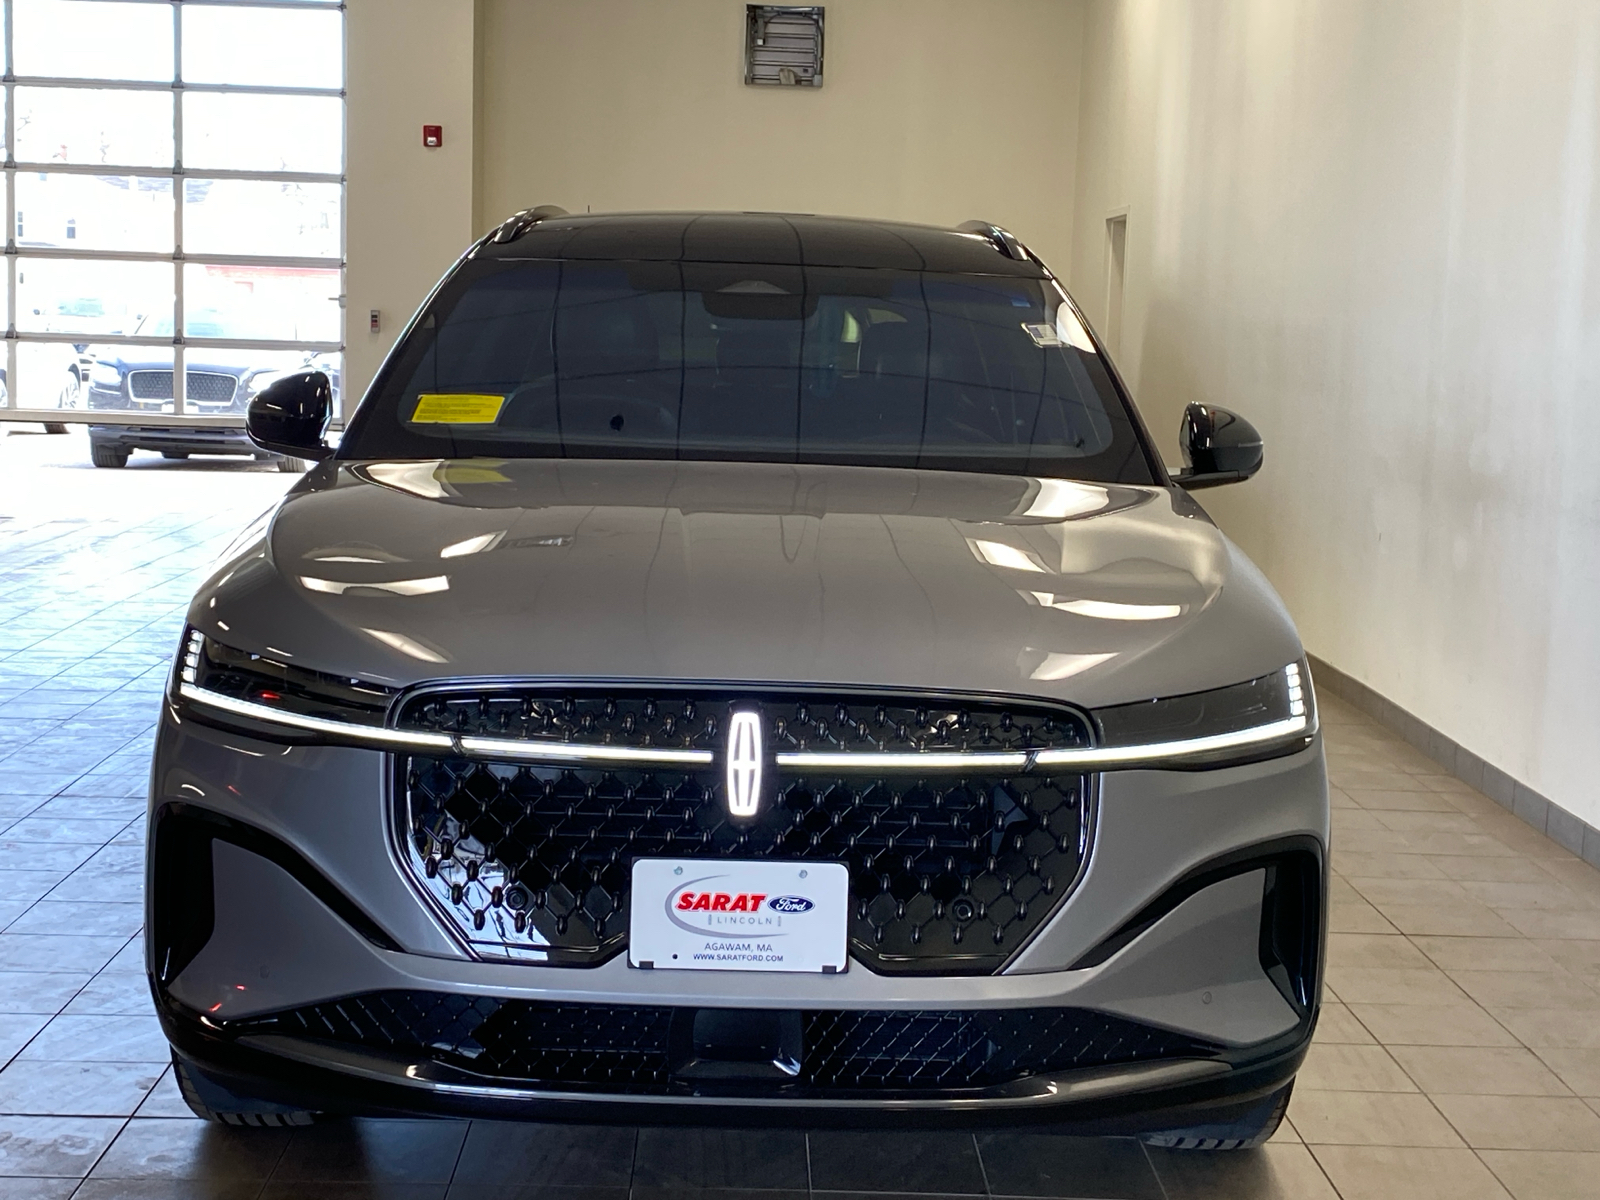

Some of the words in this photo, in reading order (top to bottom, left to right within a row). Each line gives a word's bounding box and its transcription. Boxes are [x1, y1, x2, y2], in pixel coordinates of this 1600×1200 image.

[677, 892, 767, 912] SARAT
[776, 898, 806, 911] Ford
[717, 916, 772, 925] LINCOLN
[704, 943, 754, 952] AGAWAM,
[757, 944, 773, 952] MA
[693, 953, 784, 962] WWW.SARATFORD.COM
